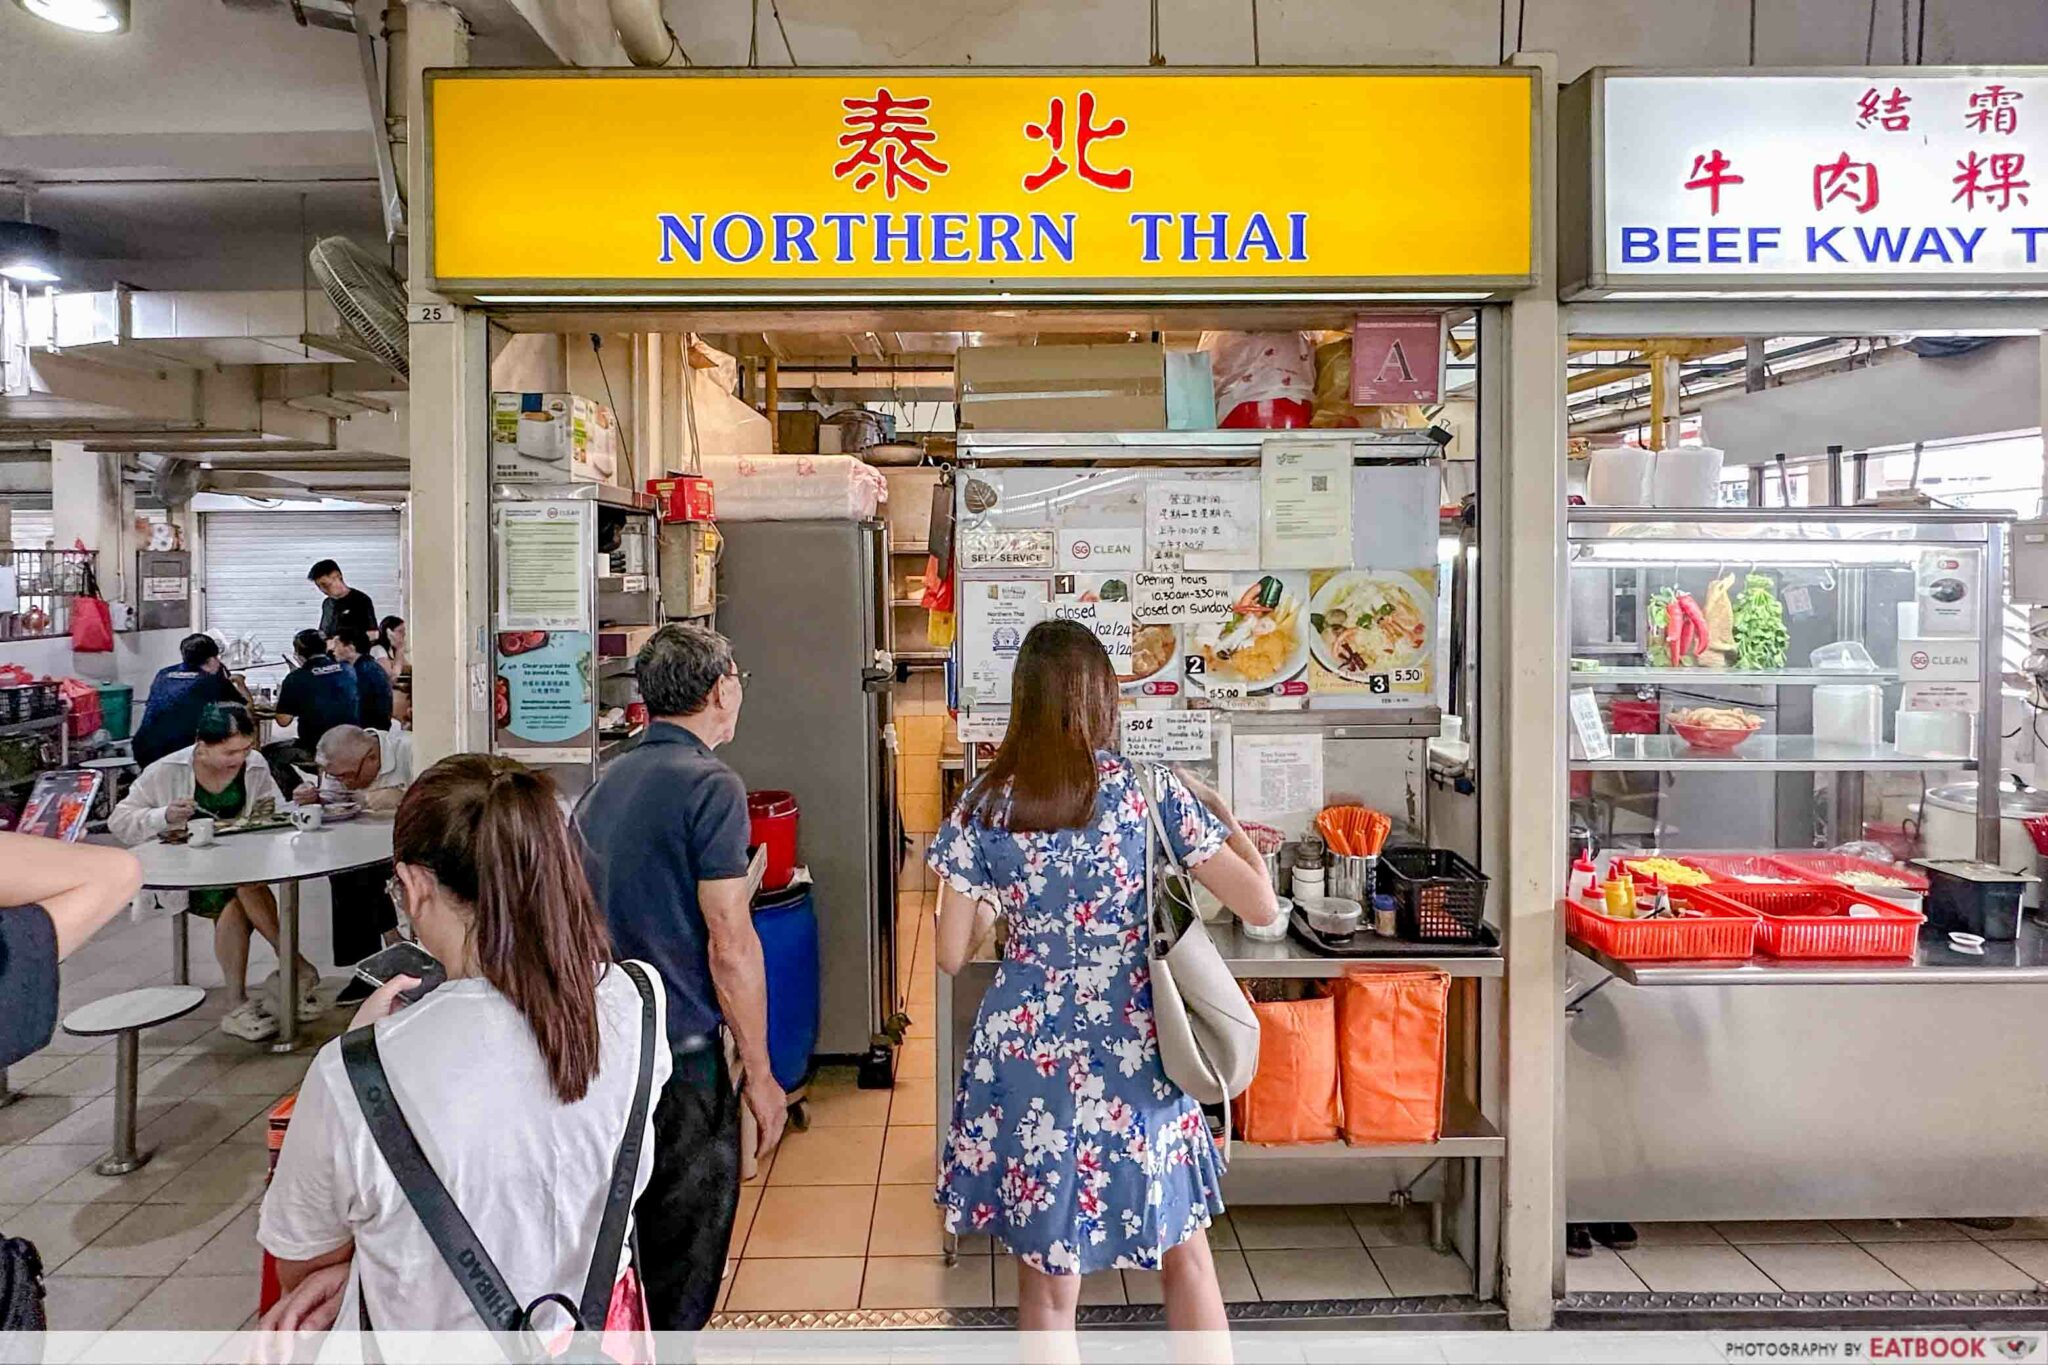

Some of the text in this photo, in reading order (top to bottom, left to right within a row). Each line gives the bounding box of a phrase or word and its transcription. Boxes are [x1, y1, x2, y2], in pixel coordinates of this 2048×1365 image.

[834, 89, 1133, 198] 泰北
[1684, 149, 2030, 216] 牛肉粿
[659, 213, 1307, 262] NORTHERN THAI
[1621, 226, 1781, 264] BEEF
[1806, 226, 1987, 264] KWAY
[422, 307, 442, 320] 25
[1373, 338, 1418, 383] A
[1093, 545, 1131, 554] CLEAN
[1060, 577, 1070, 593] 1
[1135, 573, 1208, 589] Opening hours
[1055, 603, 1097, 620] closed
[1136, 603, 1234, 618] closed on Sundays
[1189, 656, 1201, 673] 2
[1931, 656, 1968, 665] CLEAN
[1373, 676, 1386, 693] 3
